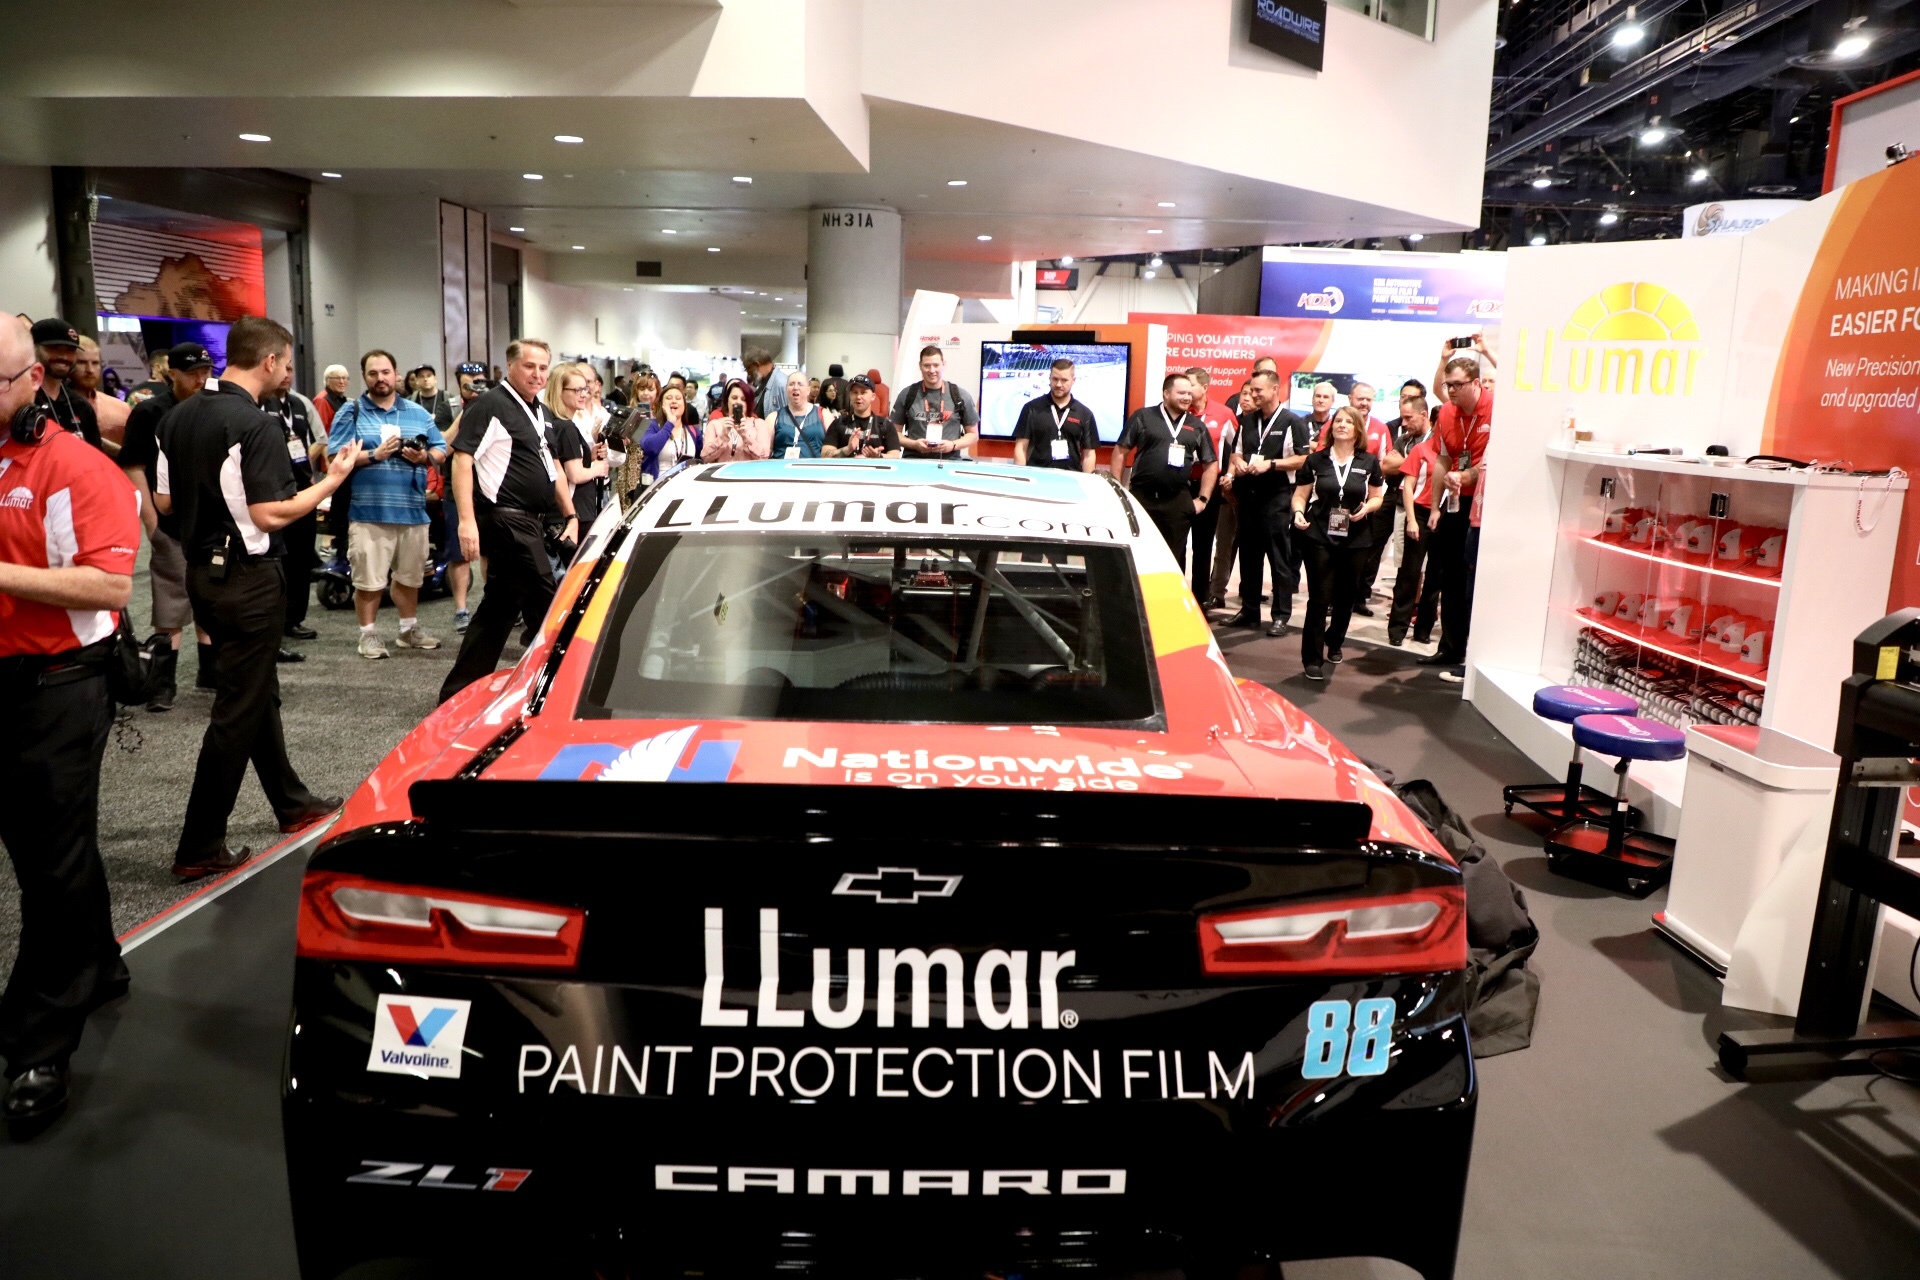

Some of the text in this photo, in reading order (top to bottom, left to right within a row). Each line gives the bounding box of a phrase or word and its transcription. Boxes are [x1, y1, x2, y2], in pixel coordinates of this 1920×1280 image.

[1257, 0, 1320, 35] ROADWIRE
[1835, 268, 1908, 300] MAKING
[1830, 308, 1897, 337] EASIER
[1166, 333, 1275, 346] PING YOU ATTRACT
[1166, 347, 1256, 359] RE CUSTOMERS
[1213, 366, 1247, 376] support
[1514, 328, 1708, 397] LLumar
[1825, 354, 1920, 377] New Precision
[1821, 387, 1918, 413] and upgraded
[653, 495, 1115, 540] LLumar.com
[782, 747, 1184, 780] Nationwide
[845, 769, 1139, 791] is on your side
[700, 907, 1076, 1030] LLumar
[1301, 997, 1395, 1079] 88
[381, 1049, 449, 1069] Valvoline
[518, 1044, 1256, 1100] PAINT PROTECTION FILM
[346, 1160, 532, 1192] ZL1
[655, 1164, 1127, 1196] CAMARO
